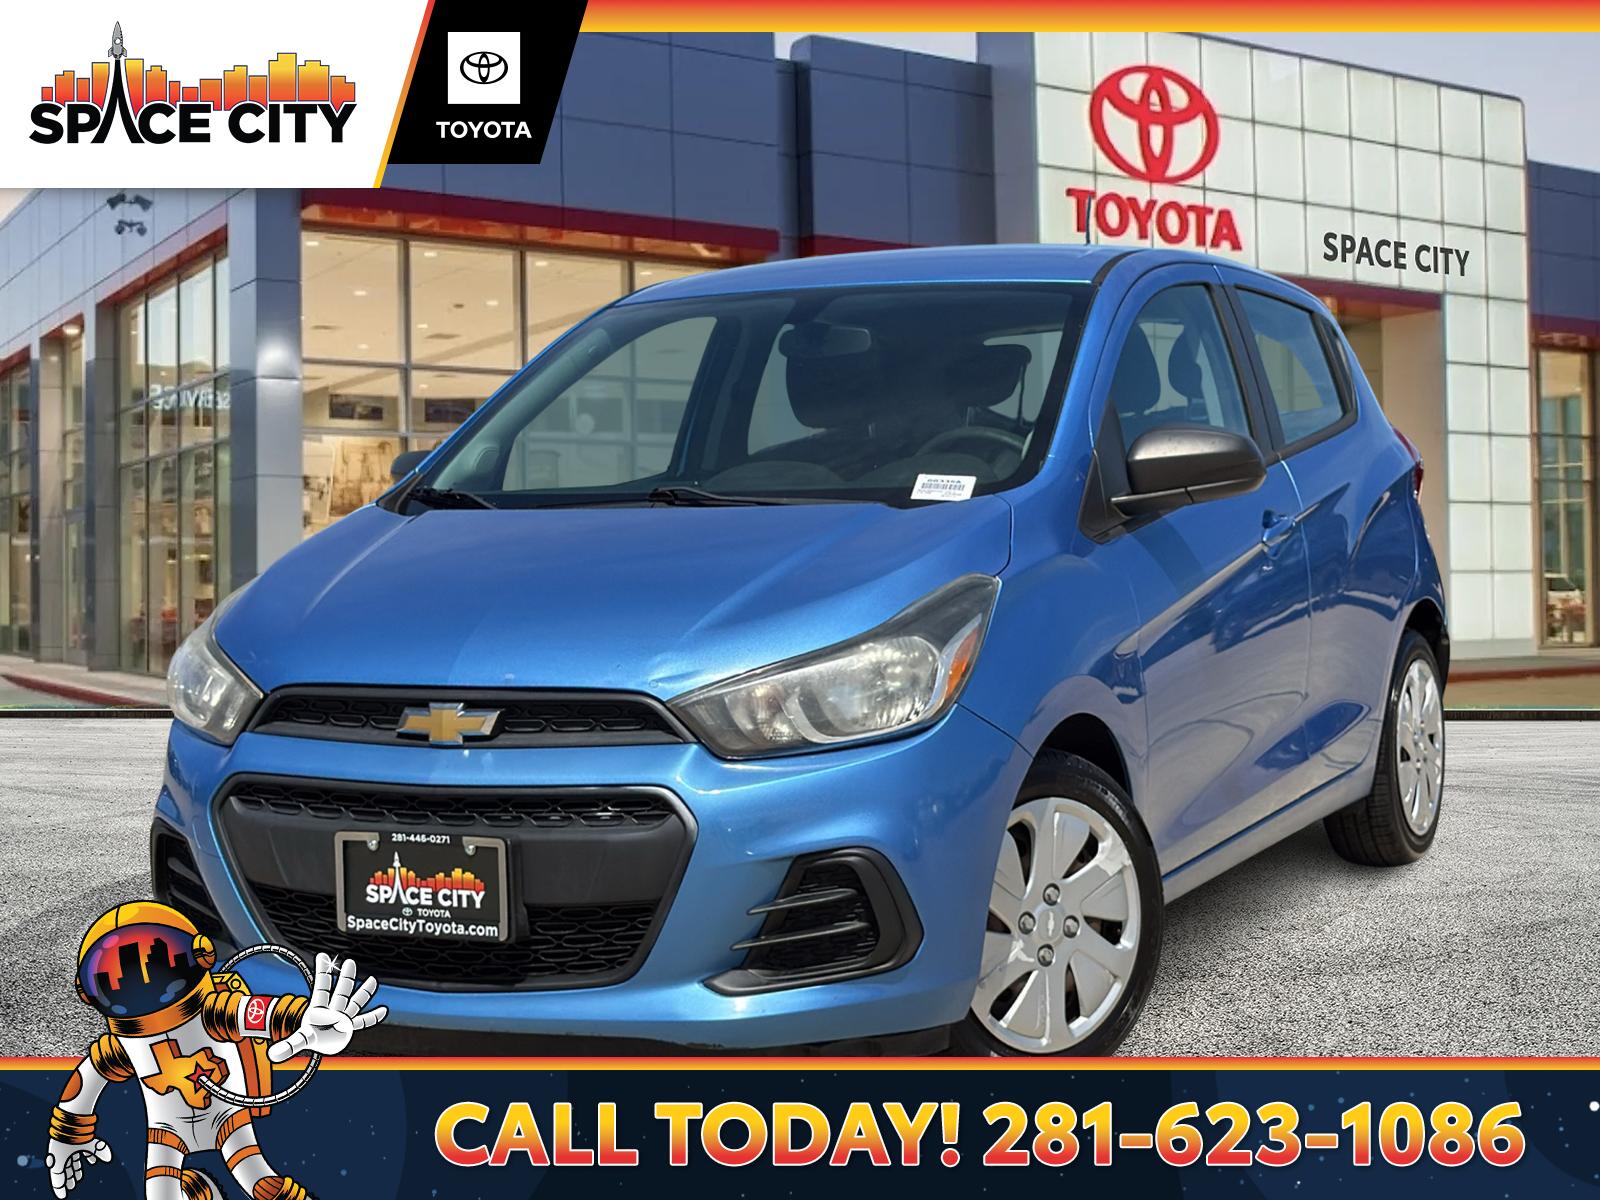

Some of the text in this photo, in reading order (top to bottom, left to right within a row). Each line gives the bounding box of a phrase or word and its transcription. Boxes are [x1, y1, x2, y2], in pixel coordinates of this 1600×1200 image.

[1066, 188, 1243, 251] TOYOTA
[1322, 232, 1470, 277] SPACE CITY
[366, 868, 485, 909] SPACE CITY
[347, 915, 498, 937] SpaceCityToyota.com
[417, 908, 451, 918] TOYOTA
